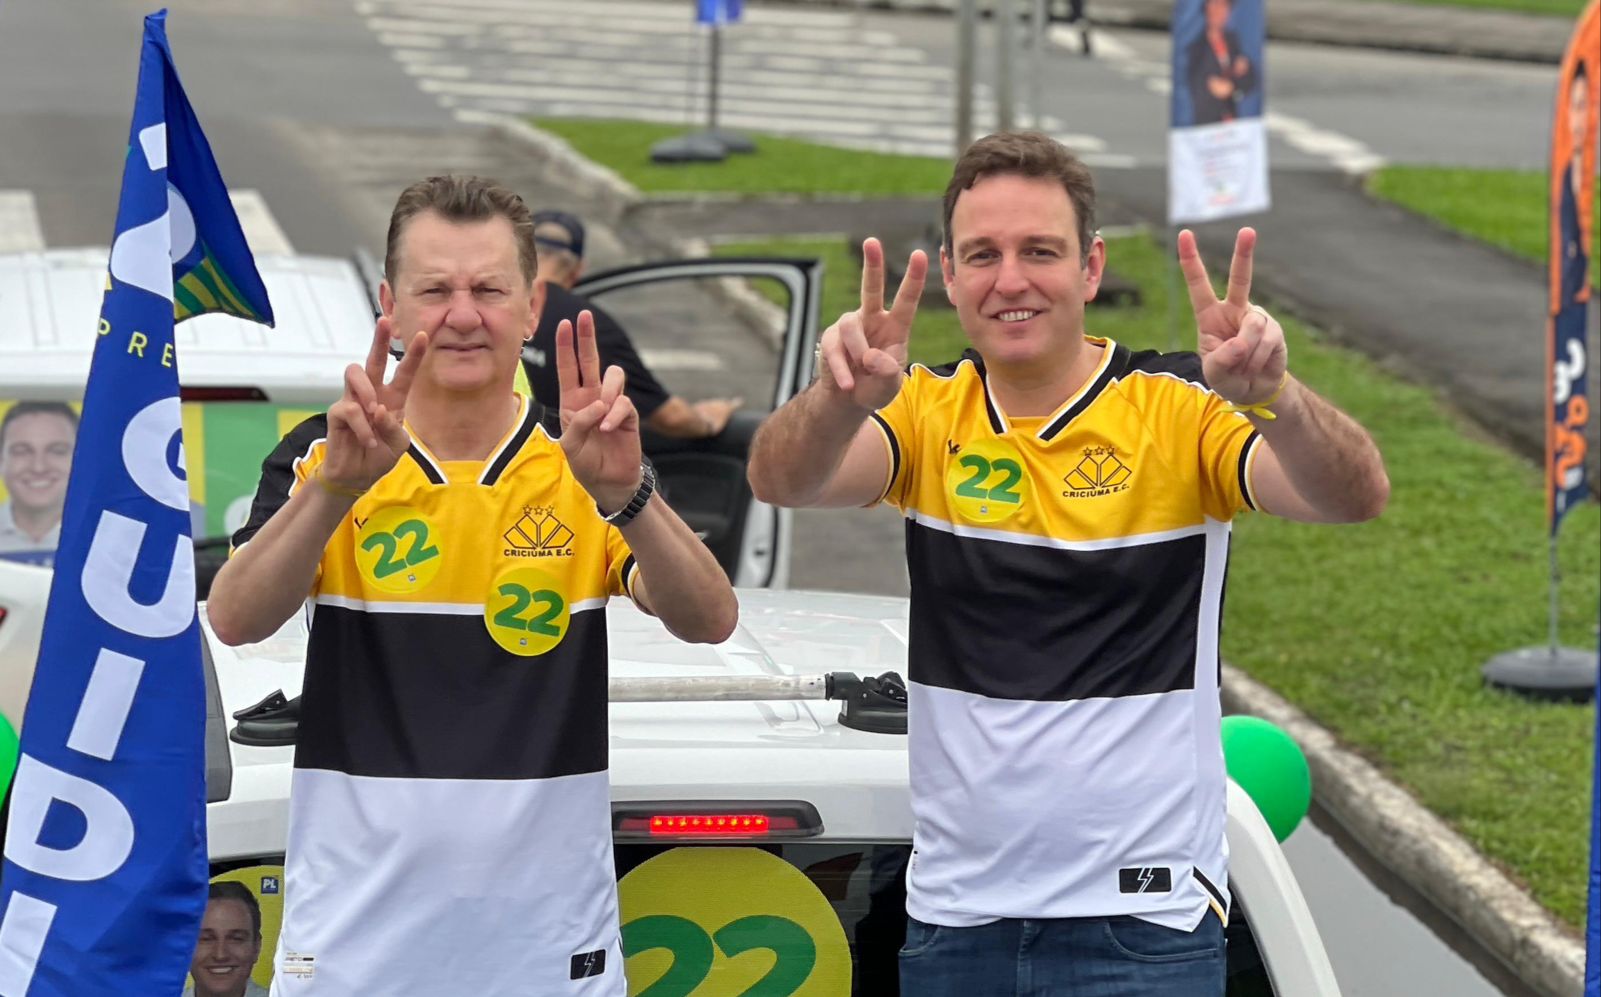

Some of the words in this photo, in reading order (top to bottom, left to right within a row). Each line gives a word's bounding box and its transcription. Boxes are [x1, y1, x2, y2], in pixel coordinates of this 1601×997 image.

[956, 454, 1022, 504] 22
[361, 519, 440, 579] 22
[493, 583, 564, 637] 22
[262, 877, 277, 890] PL
